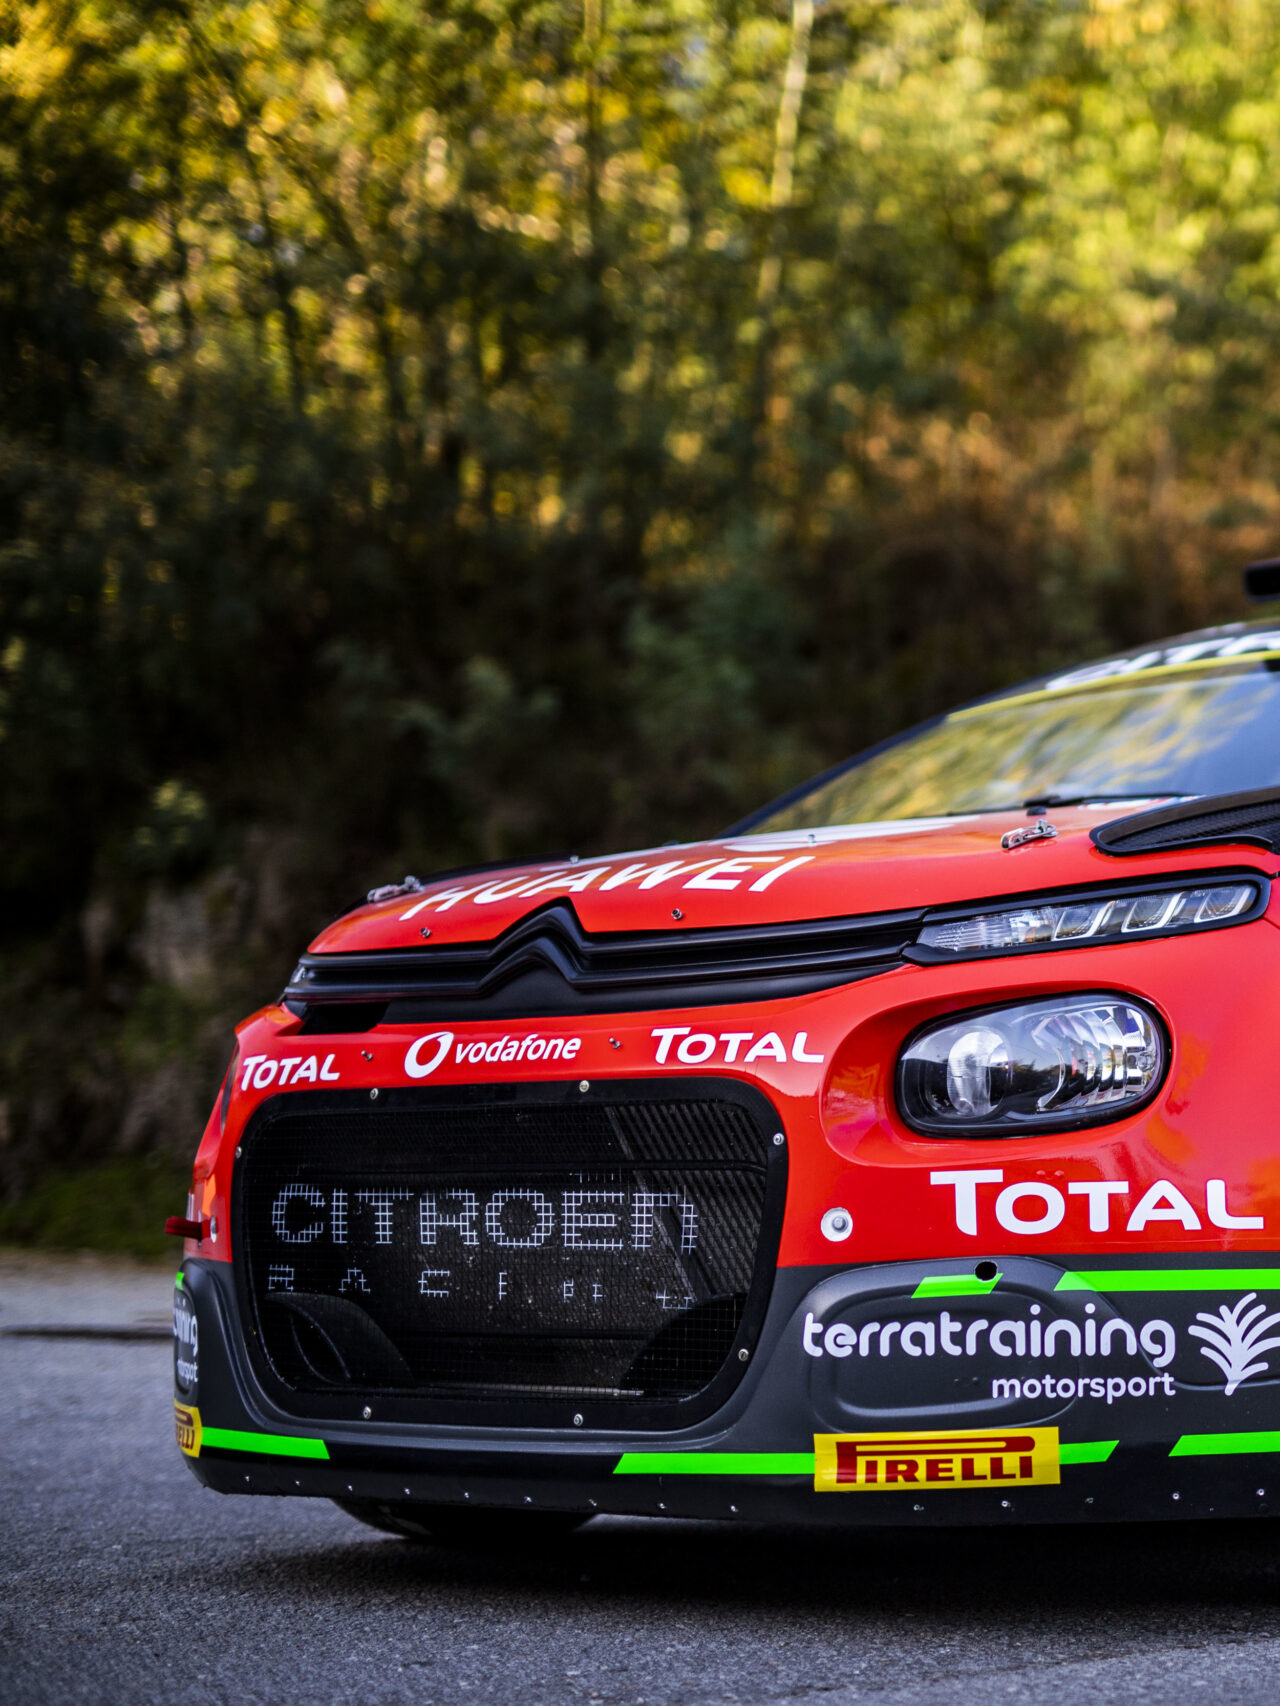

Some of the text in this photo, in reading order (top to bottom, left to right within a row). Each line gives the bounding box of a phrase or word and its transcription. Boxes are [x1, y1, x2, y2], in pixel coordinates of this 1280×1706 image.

[400, 856, 815, 921] HUAWEI
[455, 1033, 582, 1065] vodafone
[651, 1026, 825, 1065] TOTAL
[241, 1053, 341, 1092] TOTAL
[930, 1168, 1265, 1236] TOTAL
[802, 1303, 1177, 1368] terratraining
[991, 1372, 1177, 1405] motorsport
[836, 1435, 1036, 1485] PIRELLI
